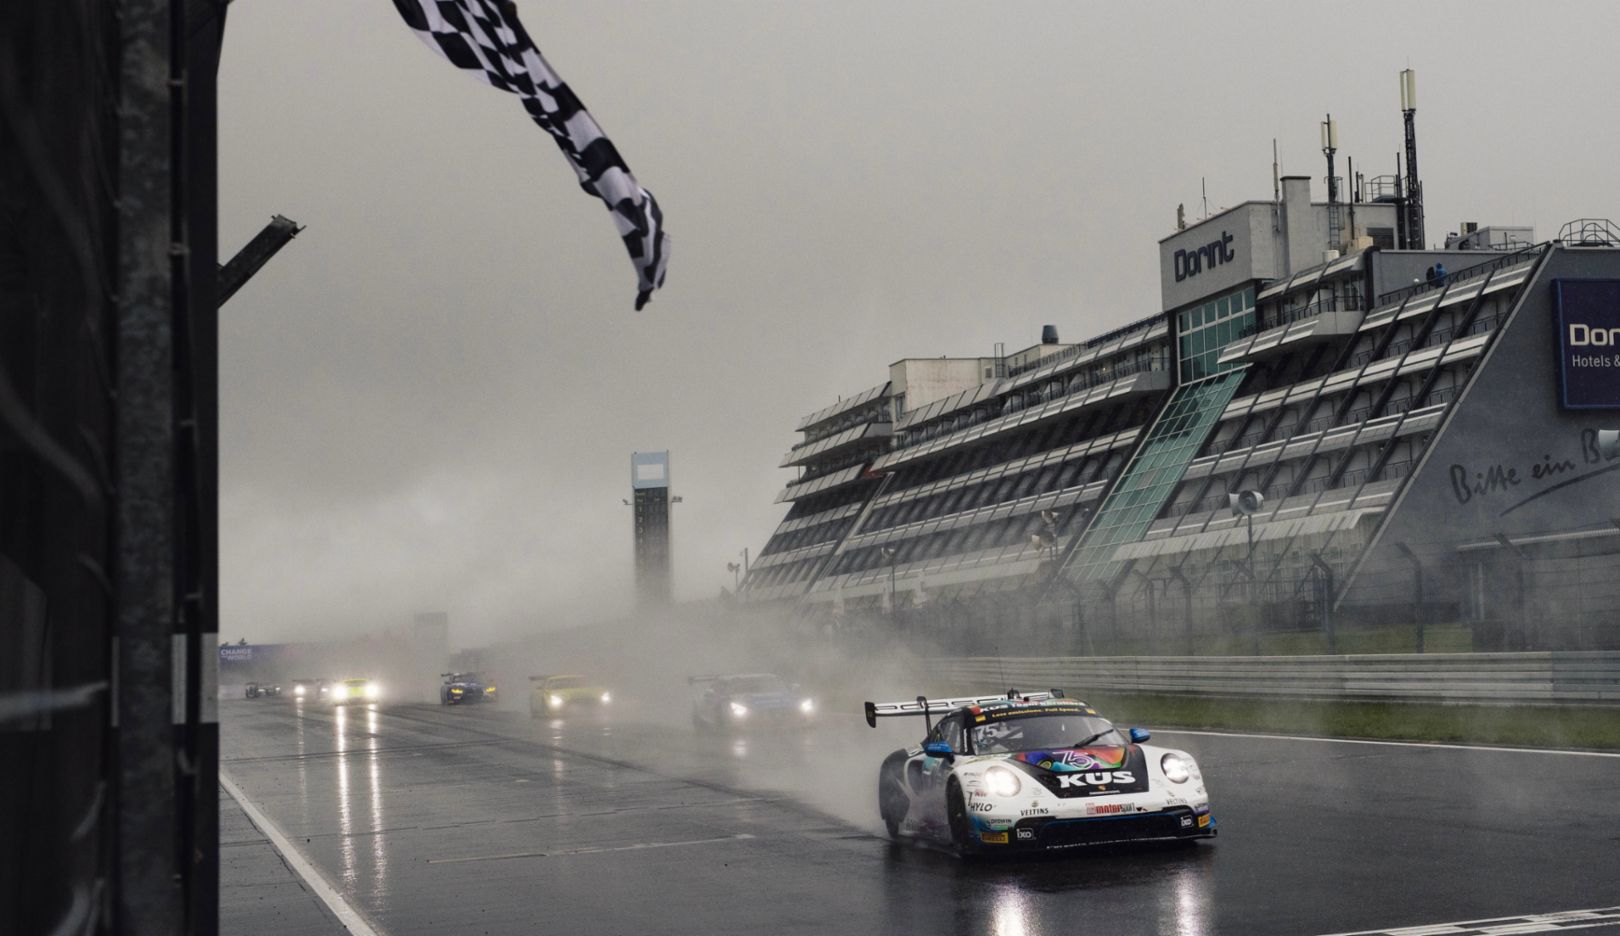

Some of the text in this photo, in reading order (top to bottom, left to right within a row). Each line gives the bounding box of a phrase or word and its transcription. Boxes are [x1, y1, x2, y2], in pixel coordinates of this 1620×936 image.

[1174, 231, 1234, 283] Dorint
[1572, 355, 1611, 368] Hotels
[1451, 464, 1521, 505] Bitte
[1532, 454, 1576, 479] ein
[975, 721, 999, 740] 75
[1053, 750, 1094, 770] 75
[970, 802, 993, 813] HYLO
[1020, 807, 1049, 817] VELTINS
[1016, 828, 1032, 839] ixo
